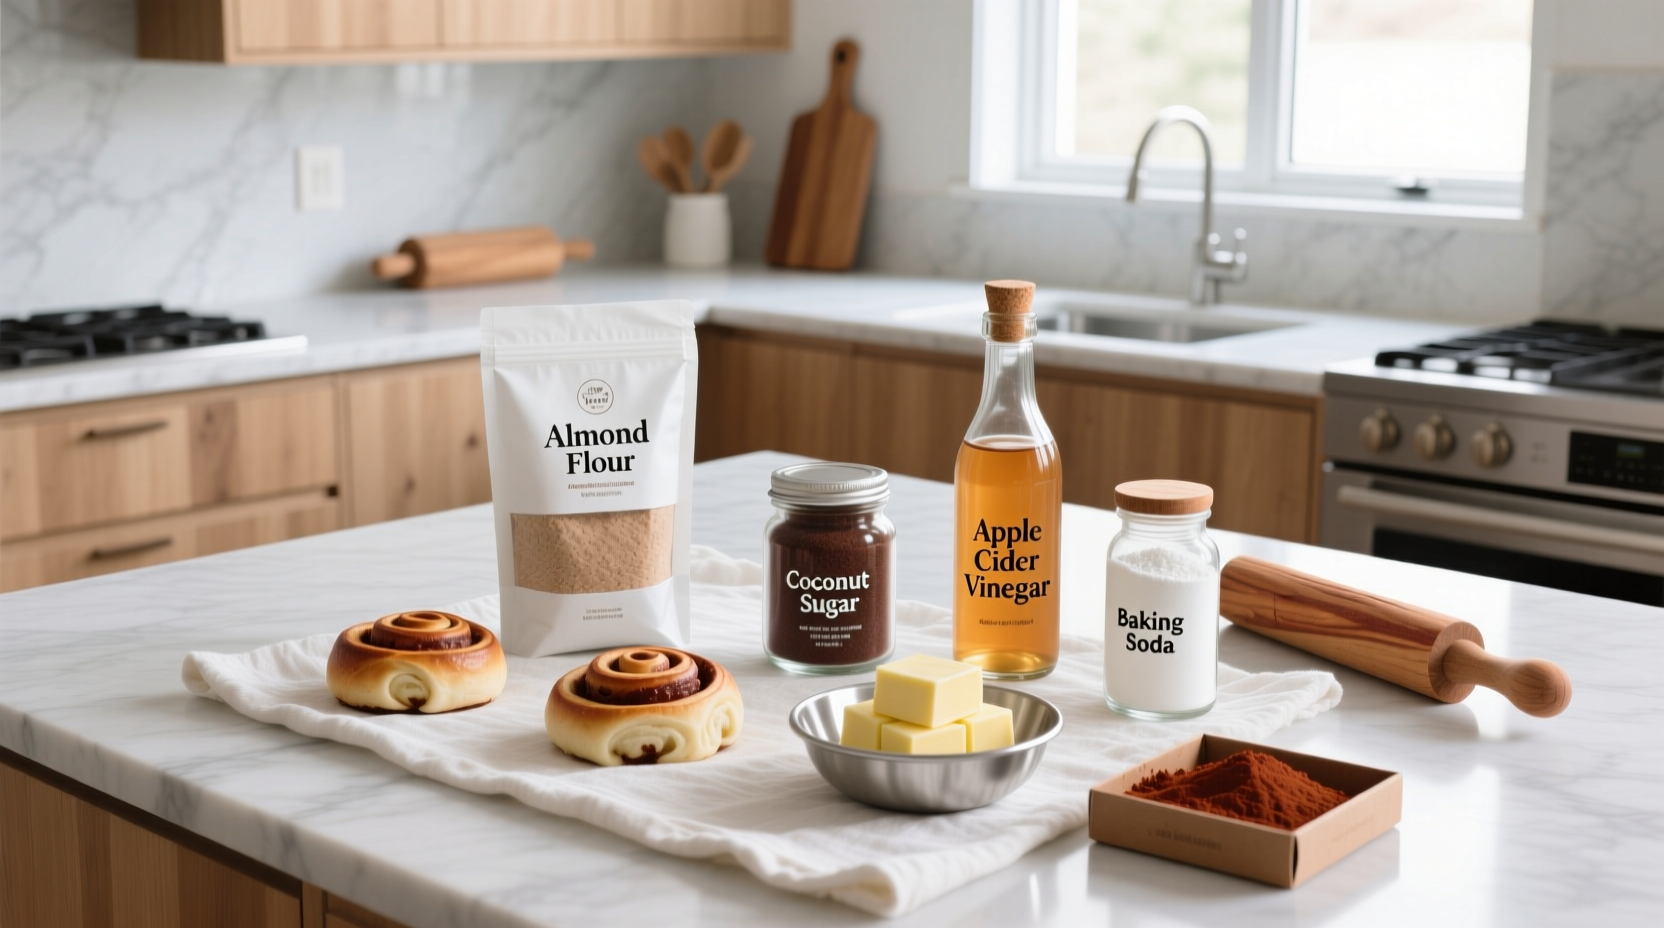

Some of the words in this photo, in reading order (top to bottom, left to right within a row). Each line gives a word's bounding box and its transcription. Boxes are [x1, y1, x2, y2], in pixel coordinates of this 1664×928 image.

[544, 418, 650, 449] Almond
[566, 450, 636, 475] Flour
[973, 517, 1042, 549] Apple
[974, 548, 1040, 572] Cider
[786, 569, 870, 591] Coconut
[964, 573, 1051, 606] Vinegar
[800, 593, 860, 619] Sugar
[1117, 607, 1184, 636] Baking
[1126, 632, 1175, 654] Soda
